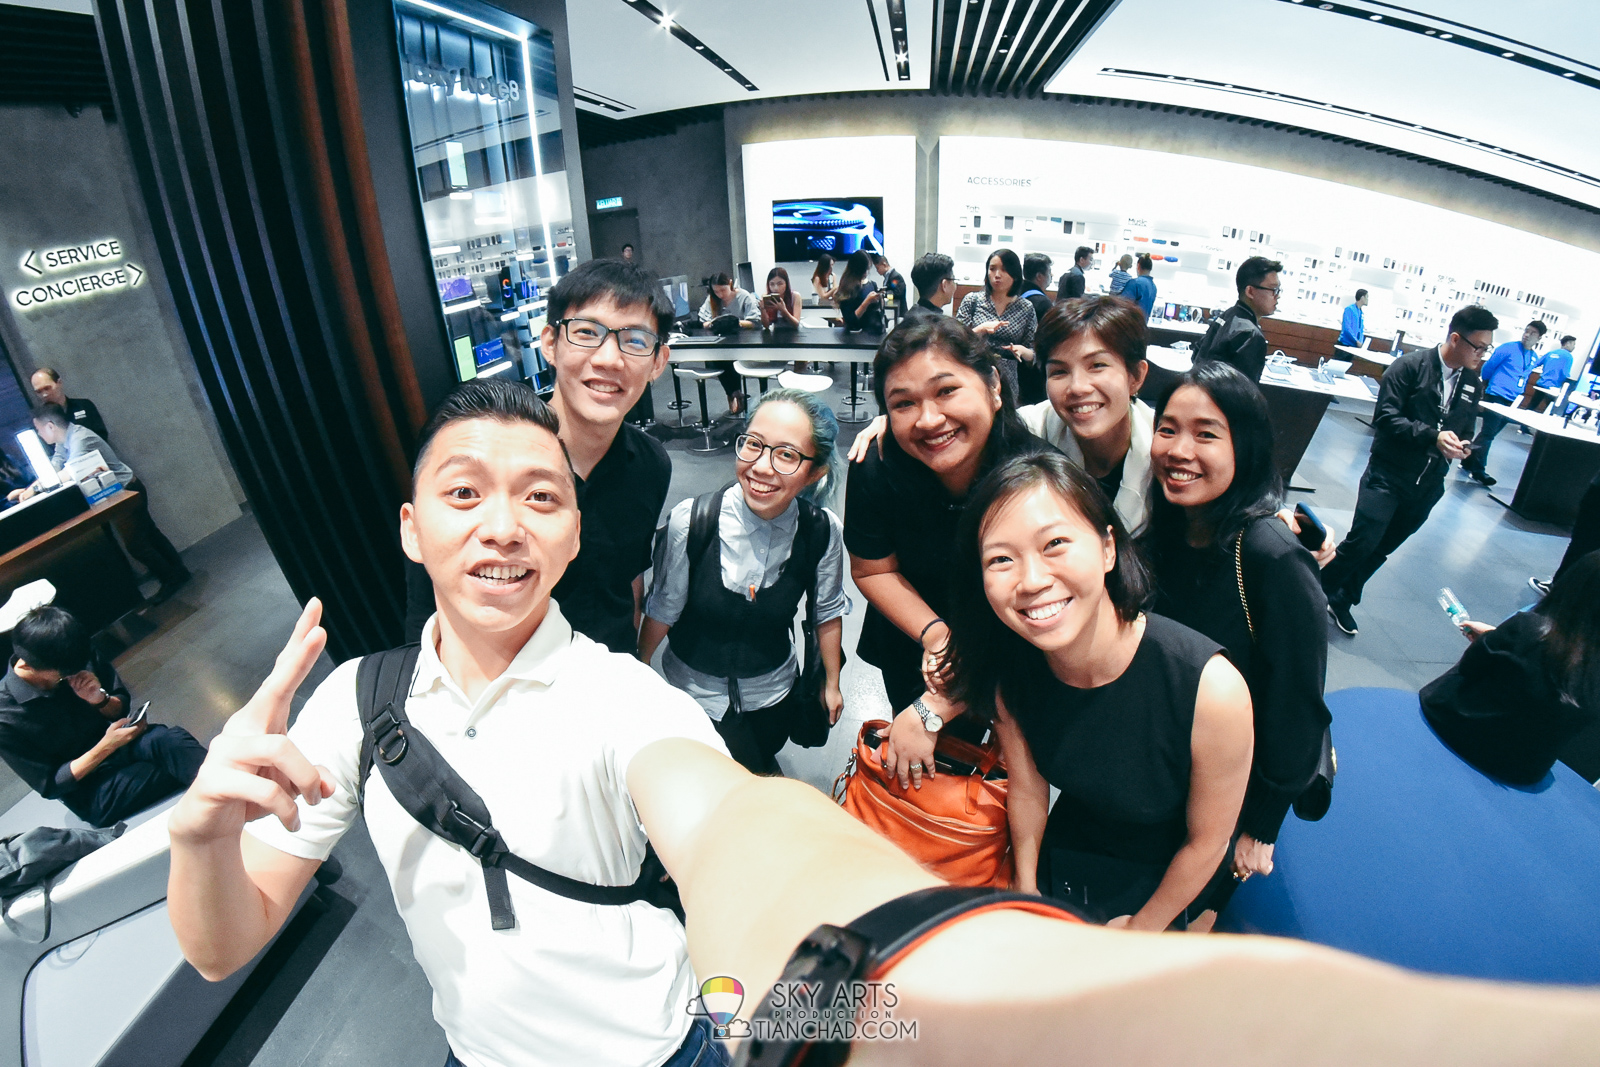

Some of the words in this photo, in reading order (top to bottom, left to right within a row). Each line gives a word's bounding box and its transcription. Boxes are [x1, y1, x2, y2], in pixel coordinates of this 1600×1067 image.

[967, 176, 1032, 187] ACCESSORIES
[46, 241, 121, 267] SERVICE
[16, 270, 127, 306] CONCIERGE
